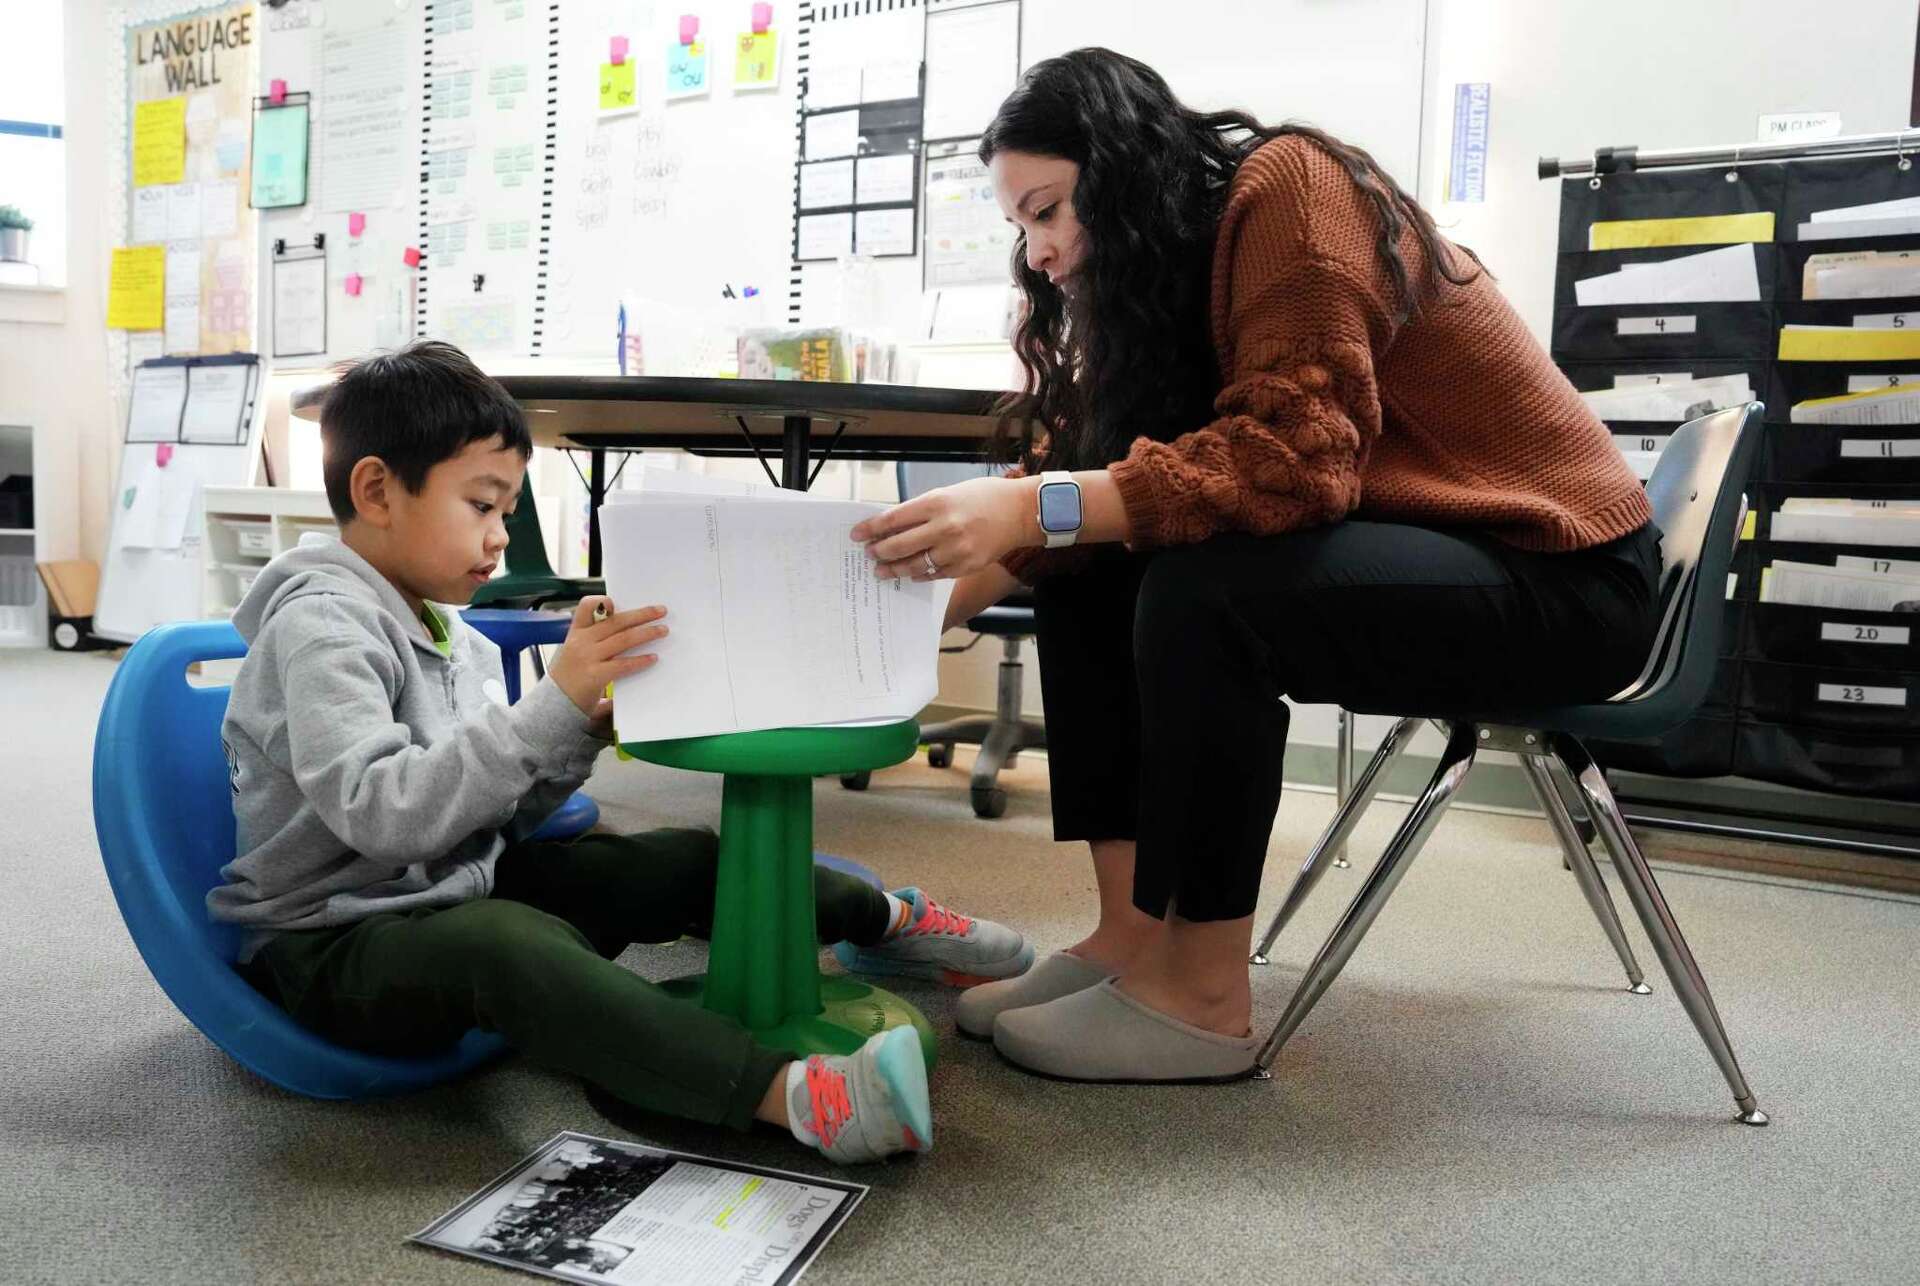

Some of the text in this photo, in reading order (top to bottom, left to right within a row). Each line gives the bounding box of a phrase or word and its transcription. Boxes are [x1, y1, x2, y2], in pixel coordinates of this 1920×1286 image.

[137, 12, 252, 66] LANGUAGE
[163, 47, 222, 93] WALL
[1770, 120, 1788, 133] PM
[1464, 84, 1488, 201] REALISTIC FICTION
[1654, 318, 1666, 332] 4
[1892, 313, 1905, 329] 5
[1640, 437, 1656, 452] 10
[1881, 441, 1893, 457] 11
[1872, 560, 1891, 574] 17
[1855, 626, 1879, 641] 20
[1842, 687, 1865, 701] 23
[785, 1194, 831, 1230] Dogs
